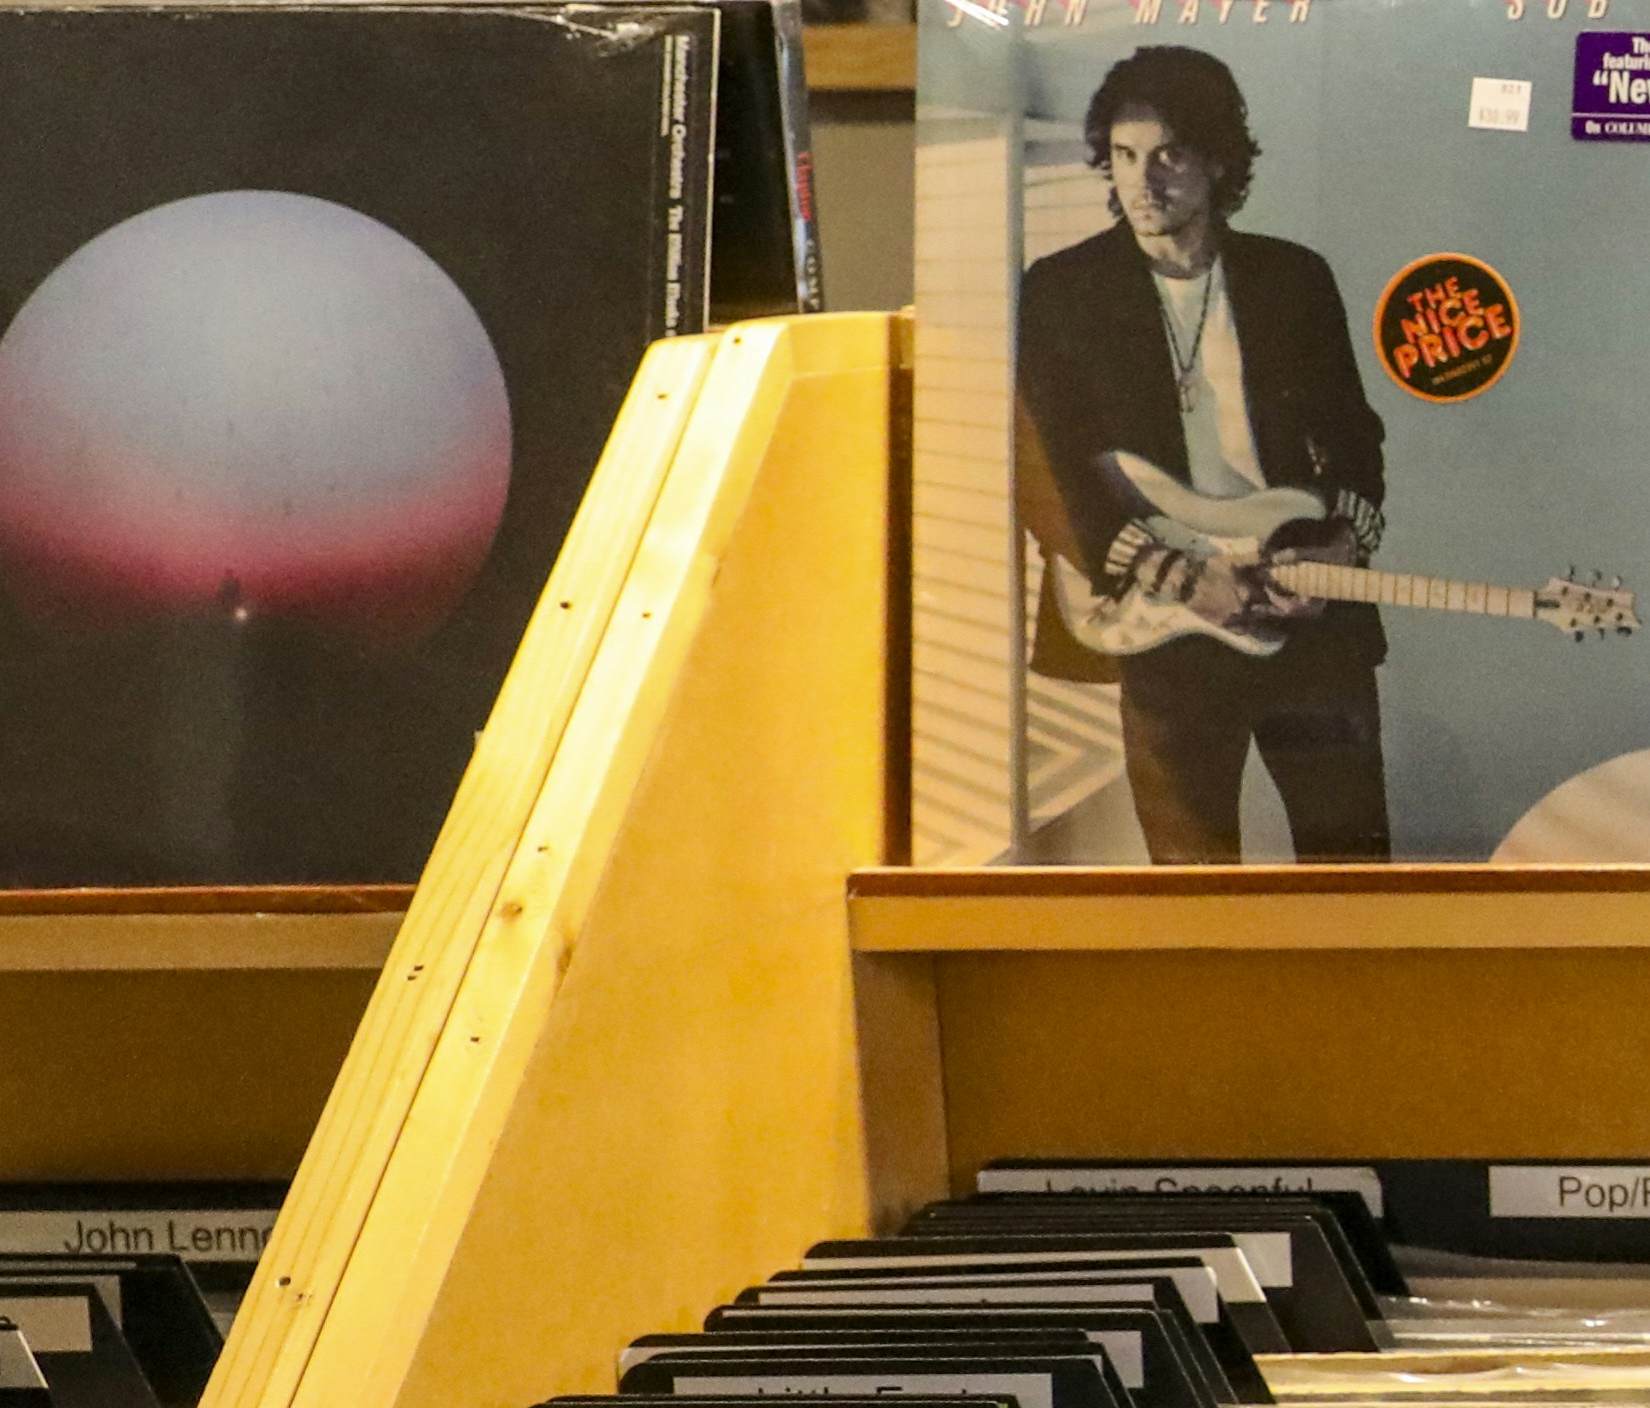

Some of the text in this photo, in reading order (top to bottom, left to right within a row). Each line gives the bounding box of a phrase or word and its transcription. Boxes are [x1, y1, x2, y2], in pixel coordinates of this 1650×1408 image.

[1585, 120, 1601, 135] On
[1408, 276, 1460, 313] THE
[1400, 287, 1485, 345] NICE
[1392, 303, 1513, 380] PRICE
[64, 1218, 158, 1254] John
